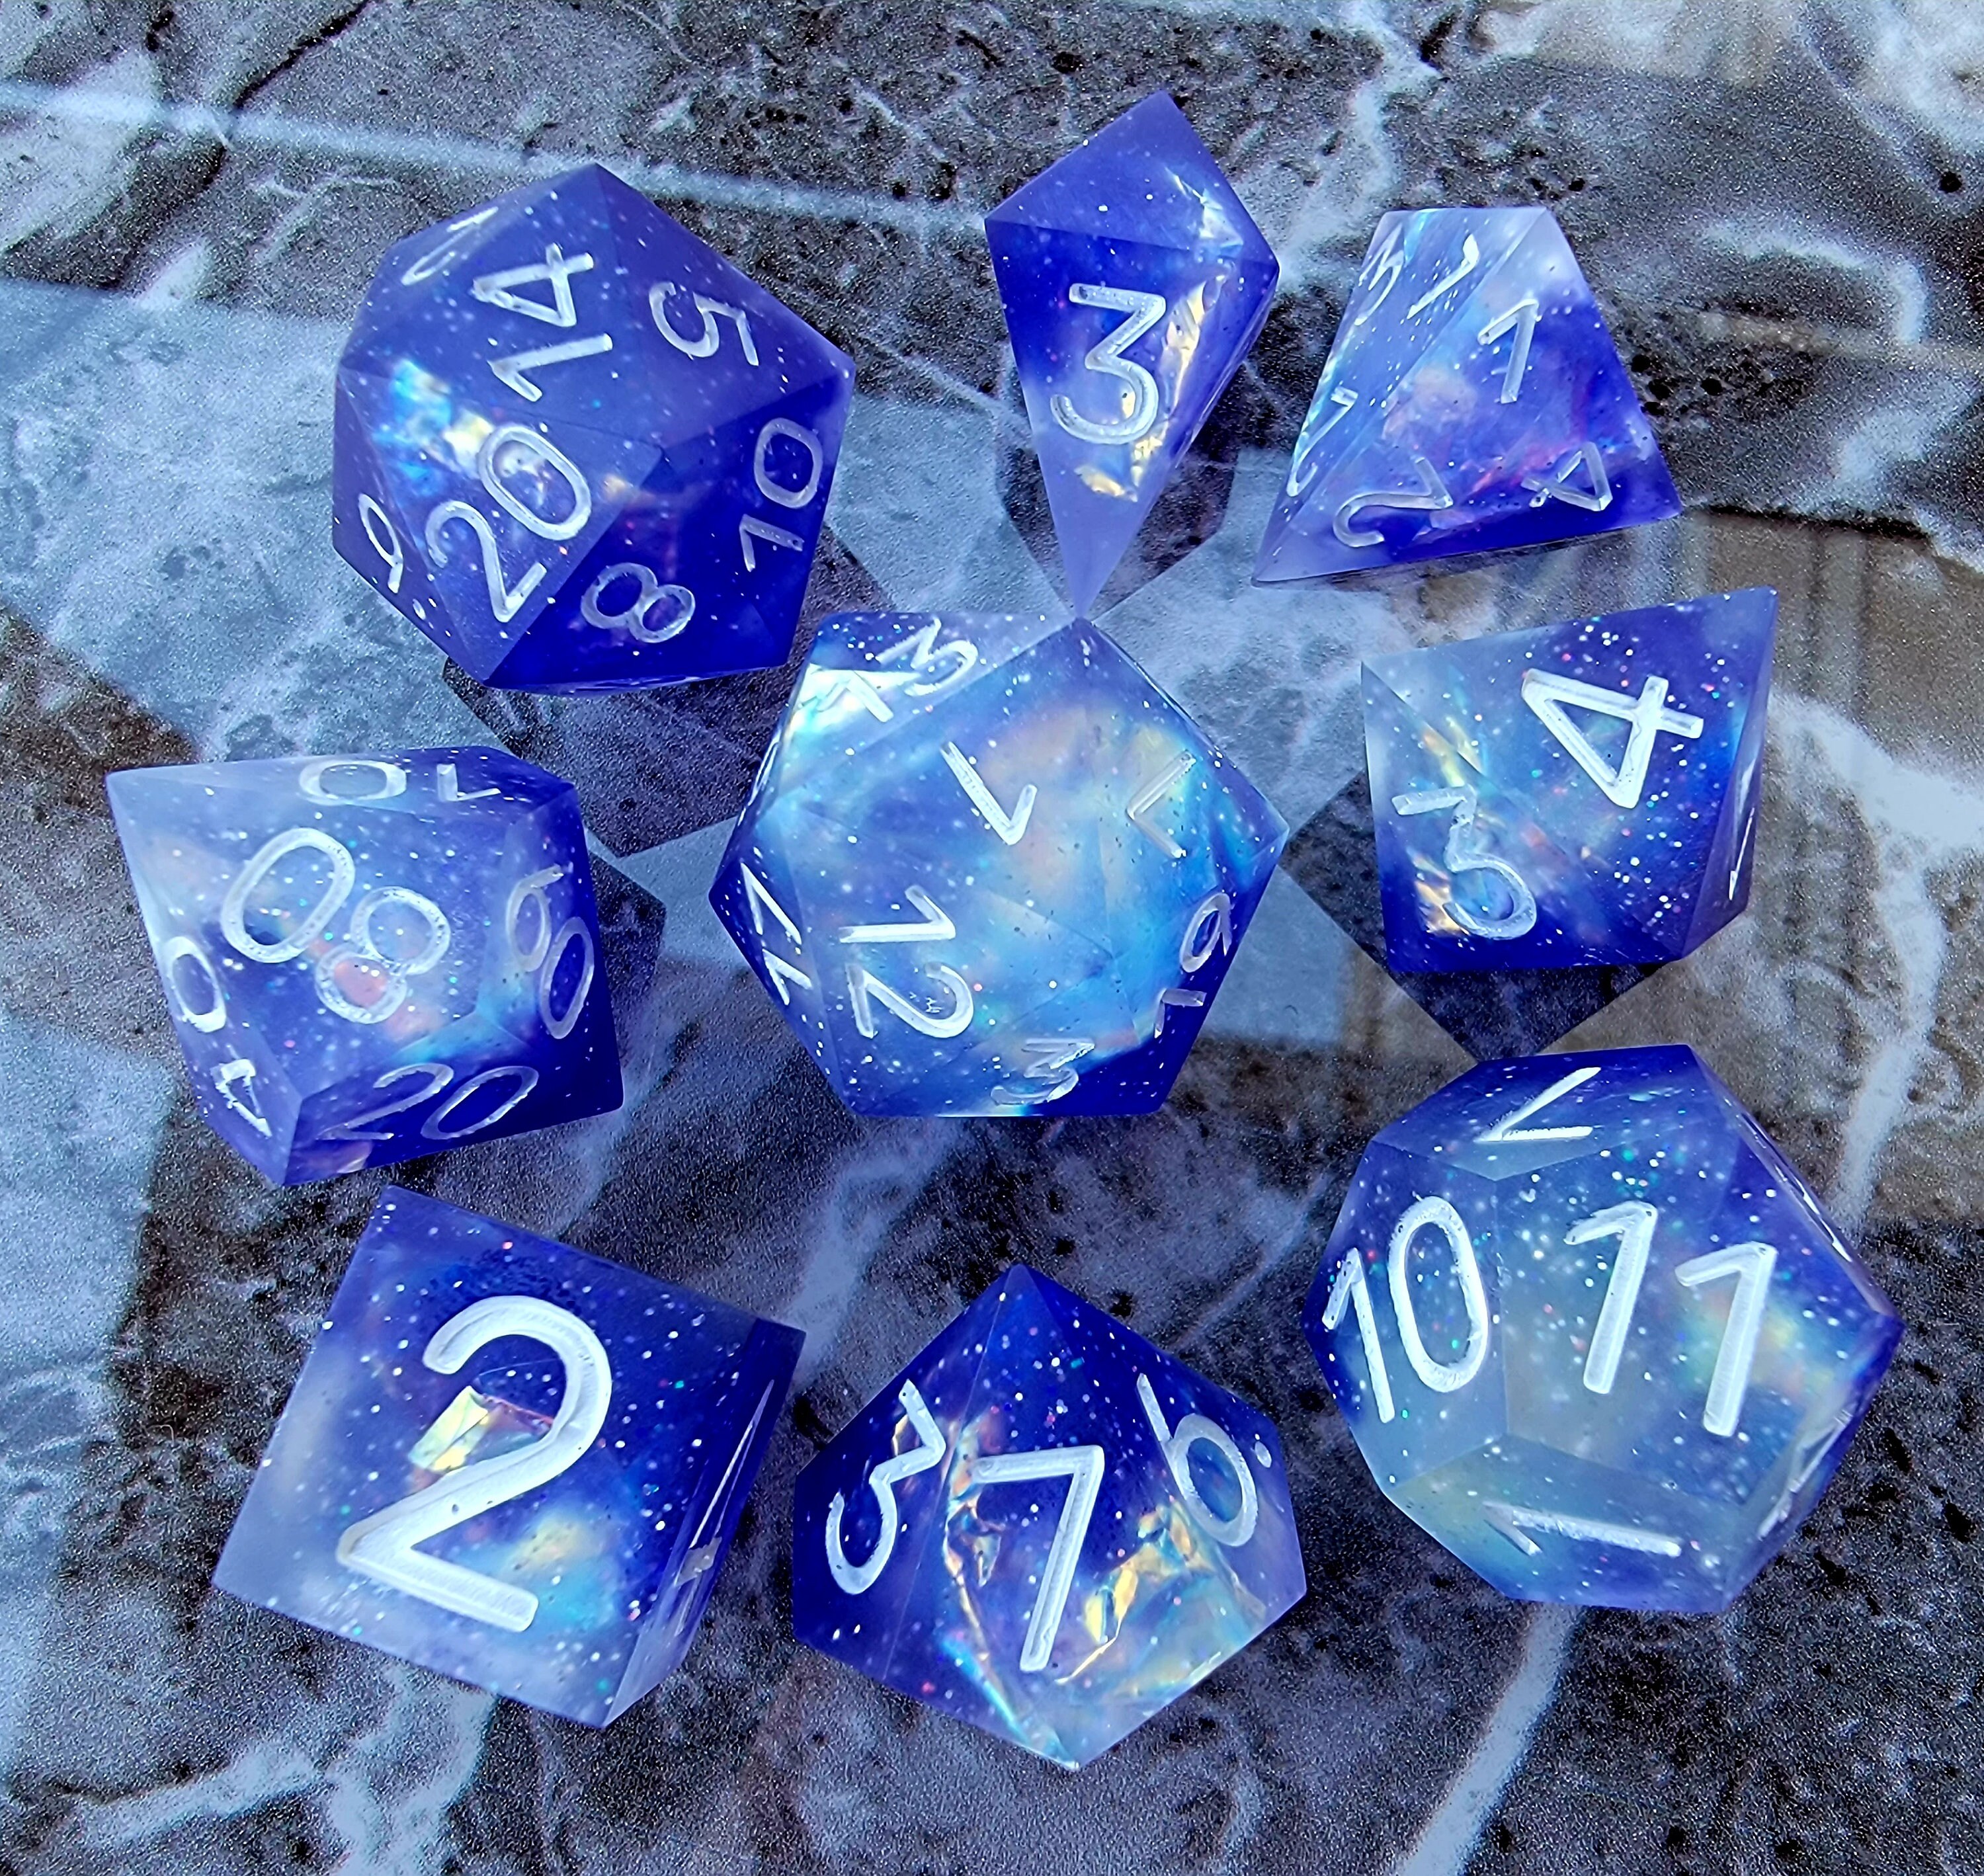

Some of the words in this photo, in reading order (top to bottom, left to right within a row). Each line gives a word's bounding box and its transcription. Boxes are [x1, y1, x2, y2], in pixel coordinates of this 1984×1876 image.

[473, 242, 613, 402] 14
[649, 280, 759, 366] 5
[1050, 283, 1166, 444] 3
[1477, 299, 1539, 404] 1
[425, 423, 591, 623] 20
[739, 417, 823, 572] 10
[1333, 456, 1454, 548] 2
[1520, 442, 1614, 512] 4
[581, 561, 696, 643] 8
[1521, 667, 1704, 809] 4
[838, 884, 975, 1040] 12
[317, 1063, 539, 1140] 20
[991, 1037, 1095, 1106] 3
[1322, 1196, 1489, 1424] 10
[1563, 1201, 1777, 1437] 11
[336, 1295, 612, 1633] 2
[825, 1378, 947, 1595] 3
[971, 1445, 1105, 1672] 7
